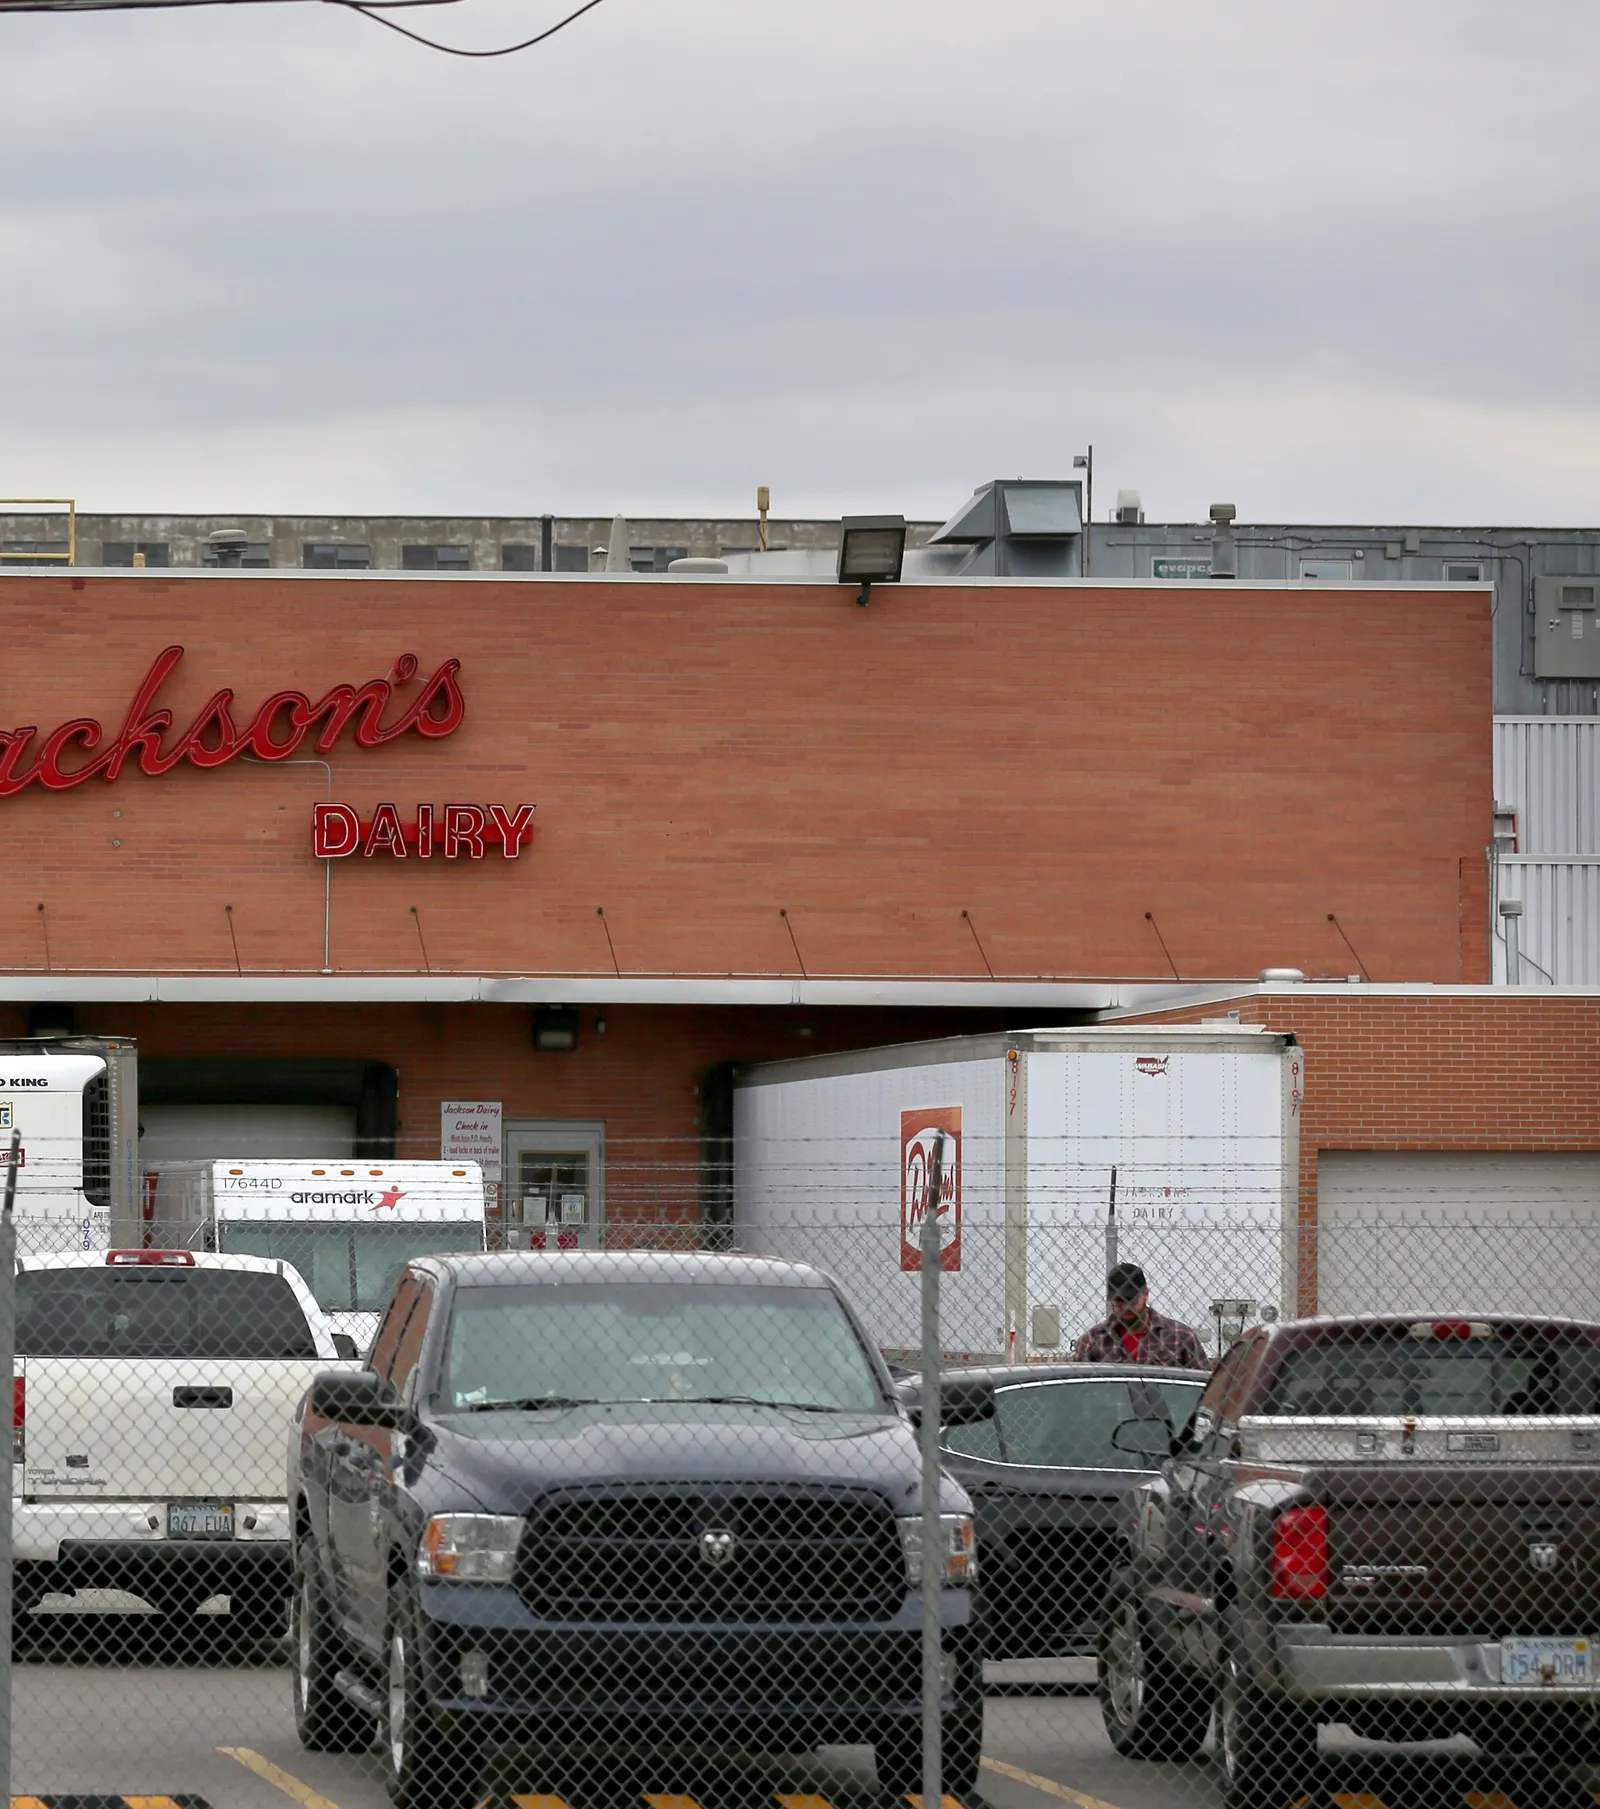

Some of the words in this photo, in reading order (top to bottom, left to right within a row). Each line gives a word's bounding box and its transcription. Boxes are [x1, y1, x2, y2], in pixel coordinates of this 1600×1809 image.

[313, 803, 535, 860] DAIRY
[9, 1078, 49, 1087] KING
[444, 1104, 475, 1114] Jackson
[476, 1104, 500, 1118] Dairy
[455, 1121, 479, 1131] Check
[480, 1121, 489, 1131] in
[223, 1178, 282, 1189] 17644D
[291, 1190, 374, 1205] aramark
[172, 1515, 197, 1533] 367
[205, 1515, 230, 1532] EUA
